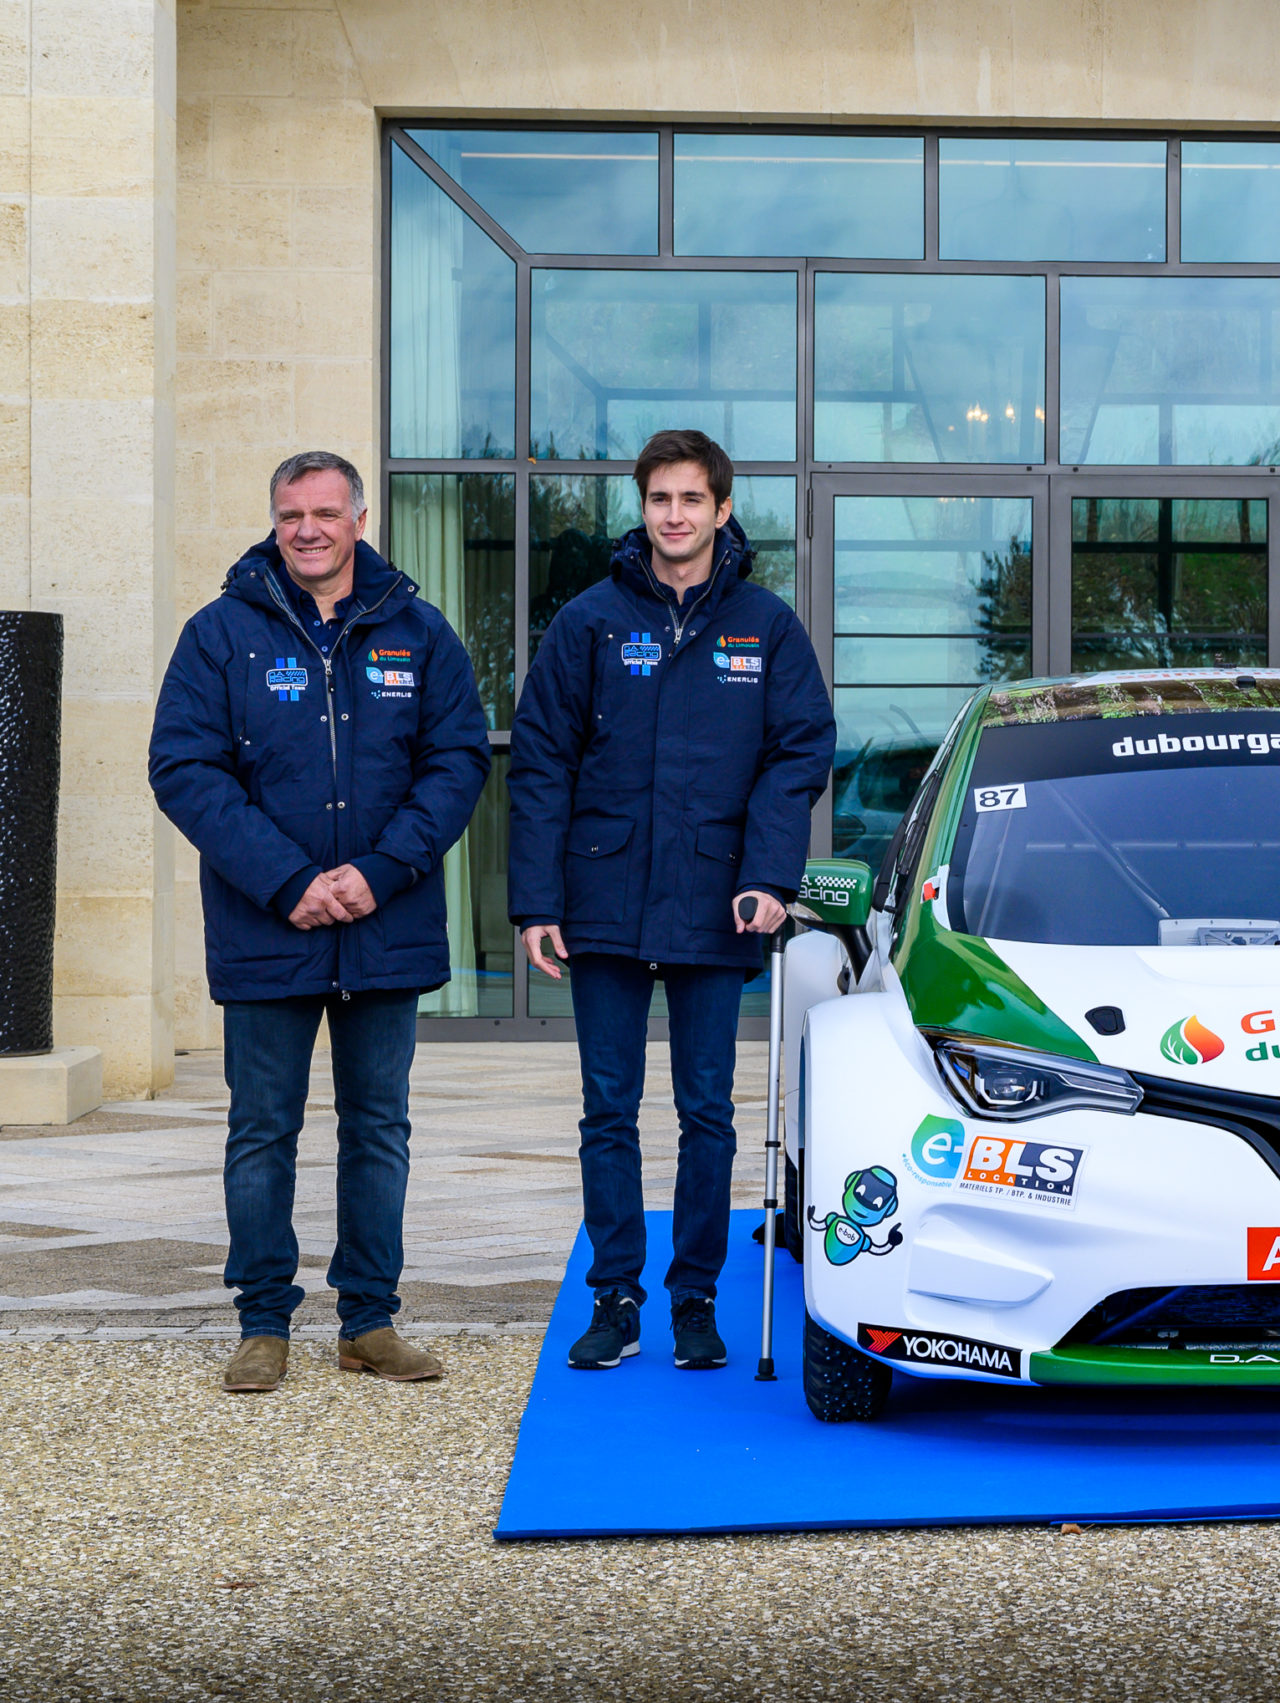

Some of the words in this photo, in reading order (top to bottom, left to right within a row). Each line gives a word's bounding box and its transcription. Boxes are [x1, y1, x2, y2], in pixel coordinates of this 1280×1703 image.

[979, 788, 1019, 807] 87
[798, 885, 850, 906] acing
[970, 1138, 1075, 1182] BLS
[968, 1171, 1071, 1193] LOCATION
[960, 1182, 993, 1194] MATERIELS
[1035, 1194, 1072, 1206] INDUSTRIE
[838, 1227, 856, 1242] e-bob
[902, 1335, 1013, 1372] YOKOHAMA
